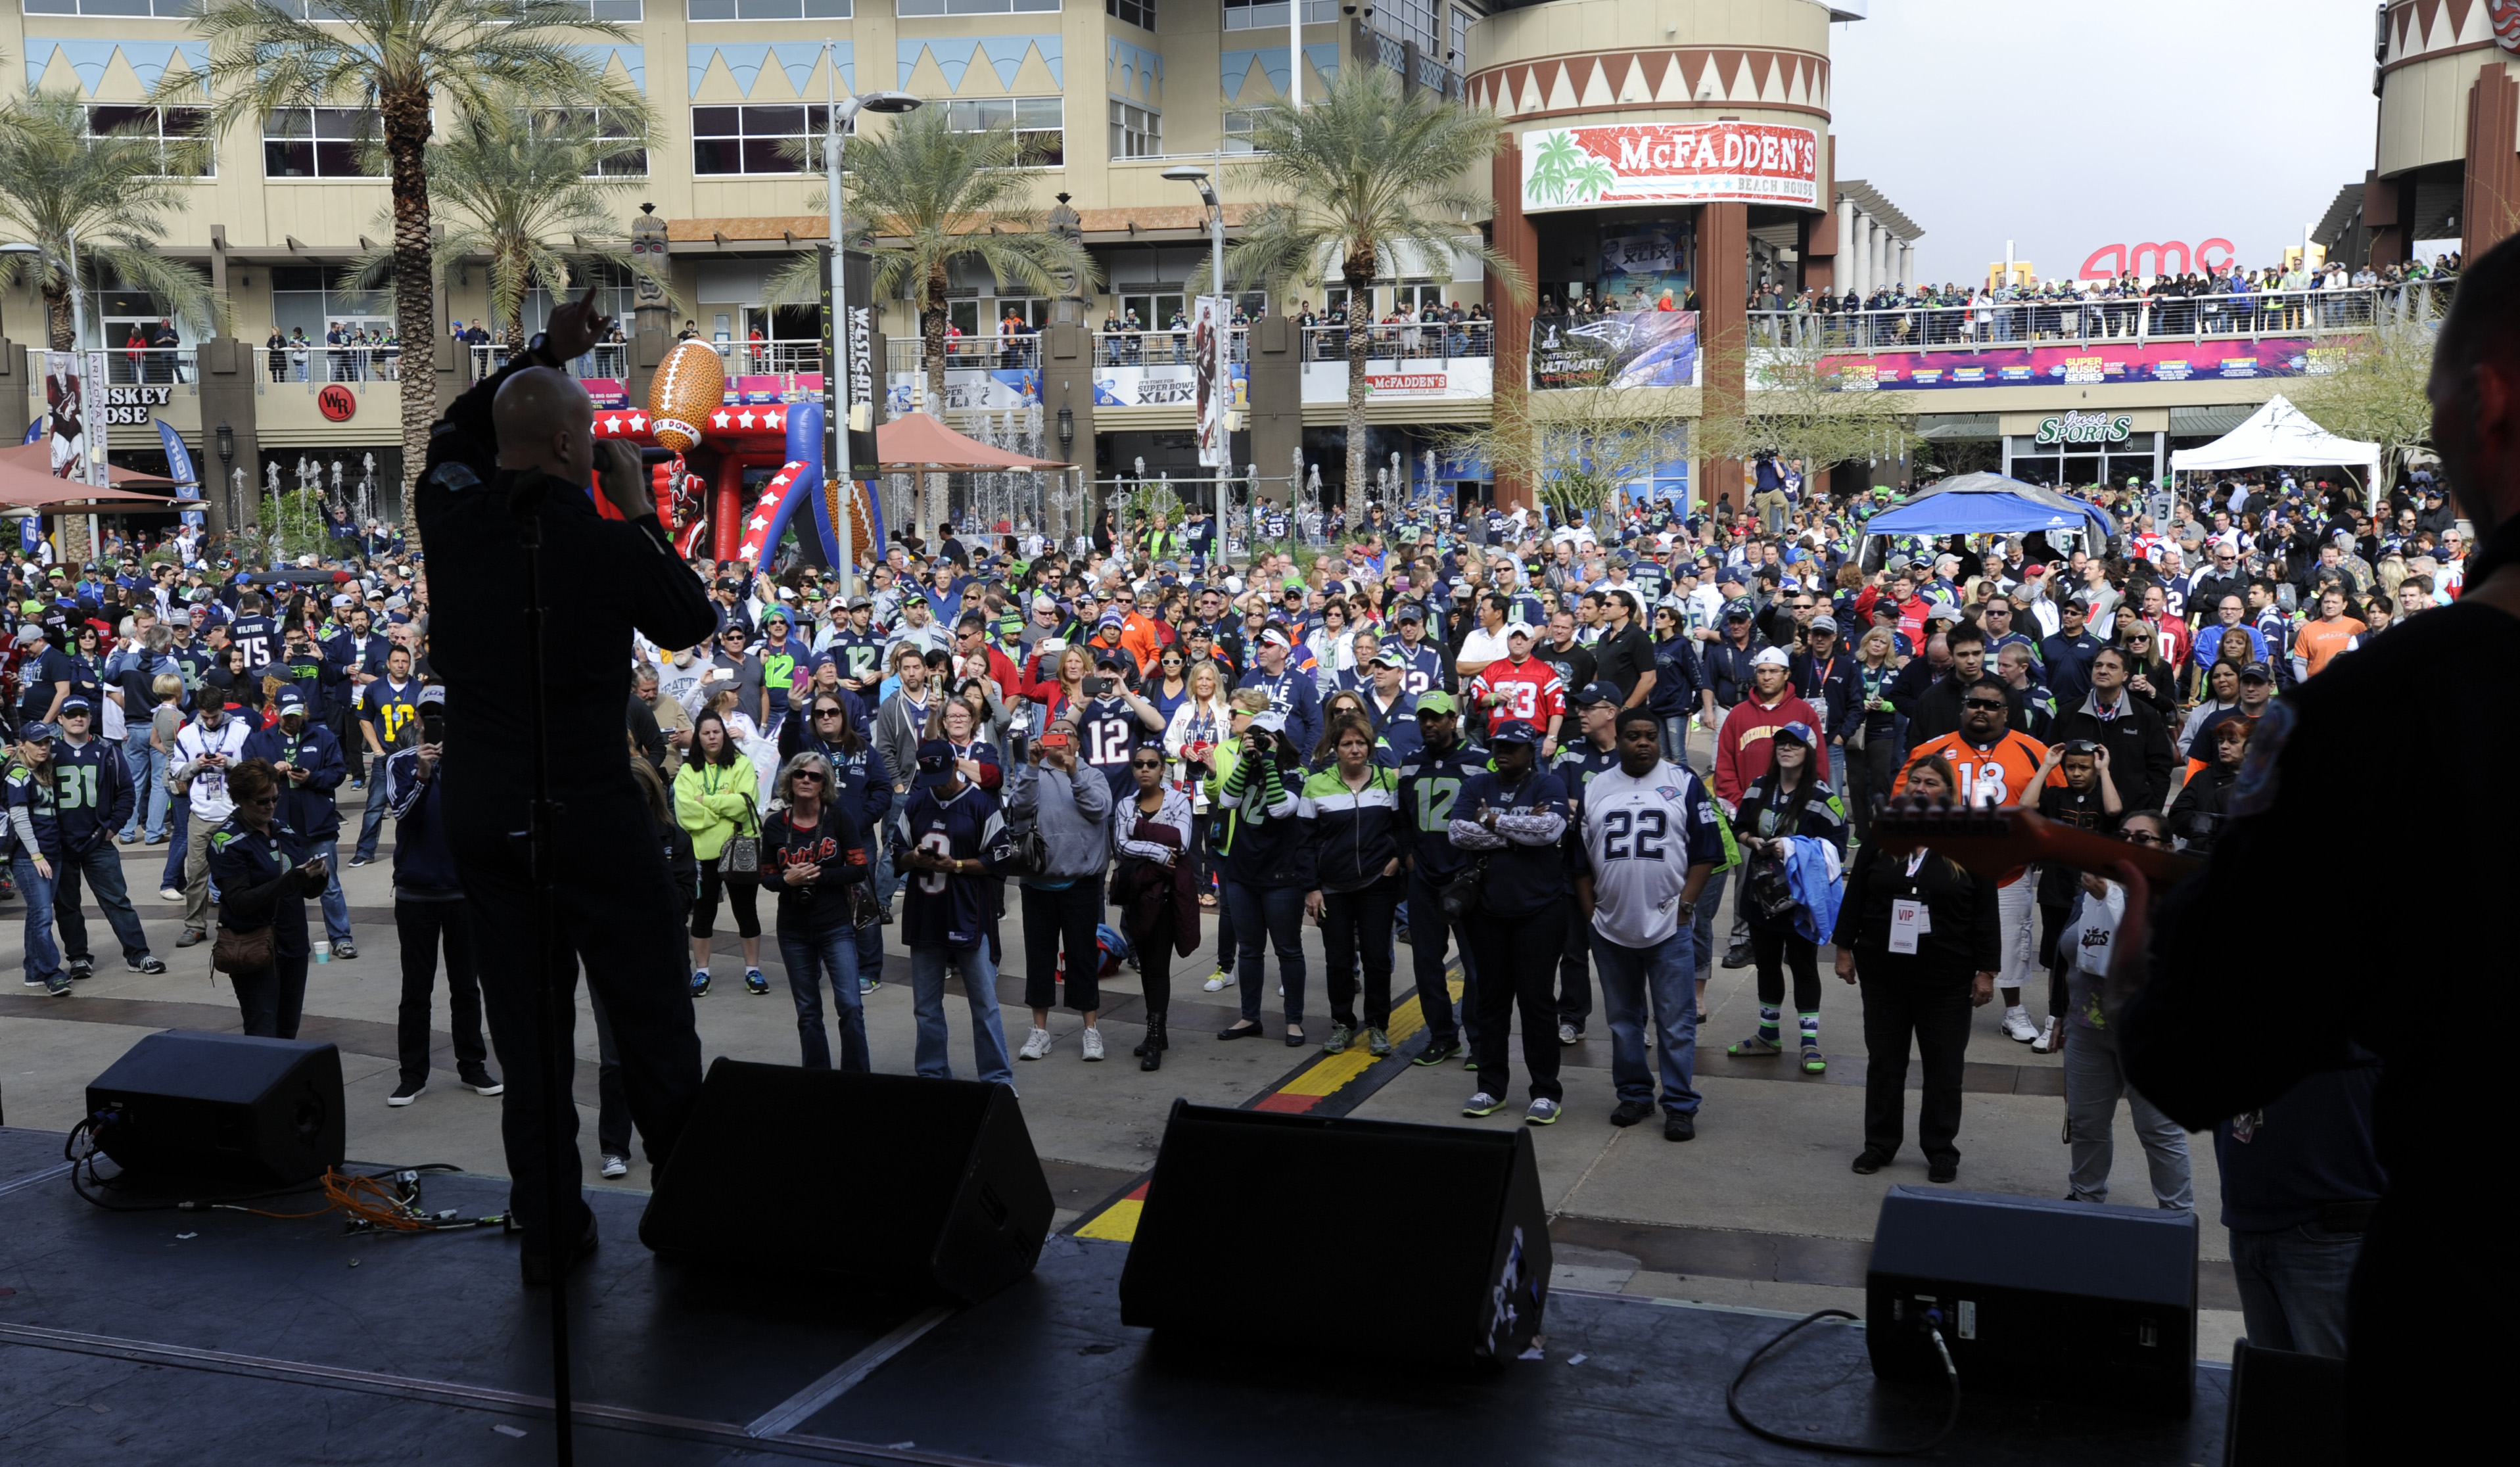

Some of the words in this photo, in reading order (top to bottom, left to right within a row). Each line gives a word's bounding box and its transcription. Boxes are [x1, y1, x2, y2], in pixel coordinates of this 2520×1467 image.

[1618, 133, 1813, 174] McFADDEN'S
[1737, 177, 1778, 193] BEACH
[1783, 179, 1813, 197] HOUSE
[1622, 248, 1670, 265] XLIX
[2079, 238, 2235, 280] amc
[822, 290, 831, 356] SHOP
[848, 306, 856, 372] ENTERTAINMENT
[1540, 358, 1606, 373] ULTIMATE
[2065, 357, 2103, 367] SUPER
[2066, 365, 2101, 374] MUSIC
[92, 356, 102, 419] ARIZONA
[1138, 383, 1167, 392] SUPER
[1168, 381, 1196, 390] BOWL
[1375, 376, 1445, 388] McFADDEN'S
[2064, 373, 2105, 383] SERIES
[824, 377, 834, 434] HERE
[1136, 389, 1196, 404] XLIX
[105, 406, 149, 424] OSE
[2064, 409, 2107, 427] Just
[668, 421, 695, 435] DOWN
[2035, 415, 2133, 444] SPORTS
[2158, 504, 2168, 520] 3
[1269, 523, 1284, 536] 53
[1489, 519, 1503, 531] 39
[2061, 535, 2070, 551] 3
[237, 624, 264, 634] WILFORK
[235, 636, 271, 668] 75
[846, 646, 875, 676] 12
[764, 655, 795, 689] 12
[1493, 681, 1538, 719] 73
[1088, 719, 1130, 765] 12
[1740, 725, 1771, 751] ARIZONA
[57, 765, 97, 808] 31
[1959, 762, 2007, 806] 18
[1414, 777, 1462, 831] 12
[1604, 808, 1668, 862] 22
[1898, 909, 1914, 921] VIP
